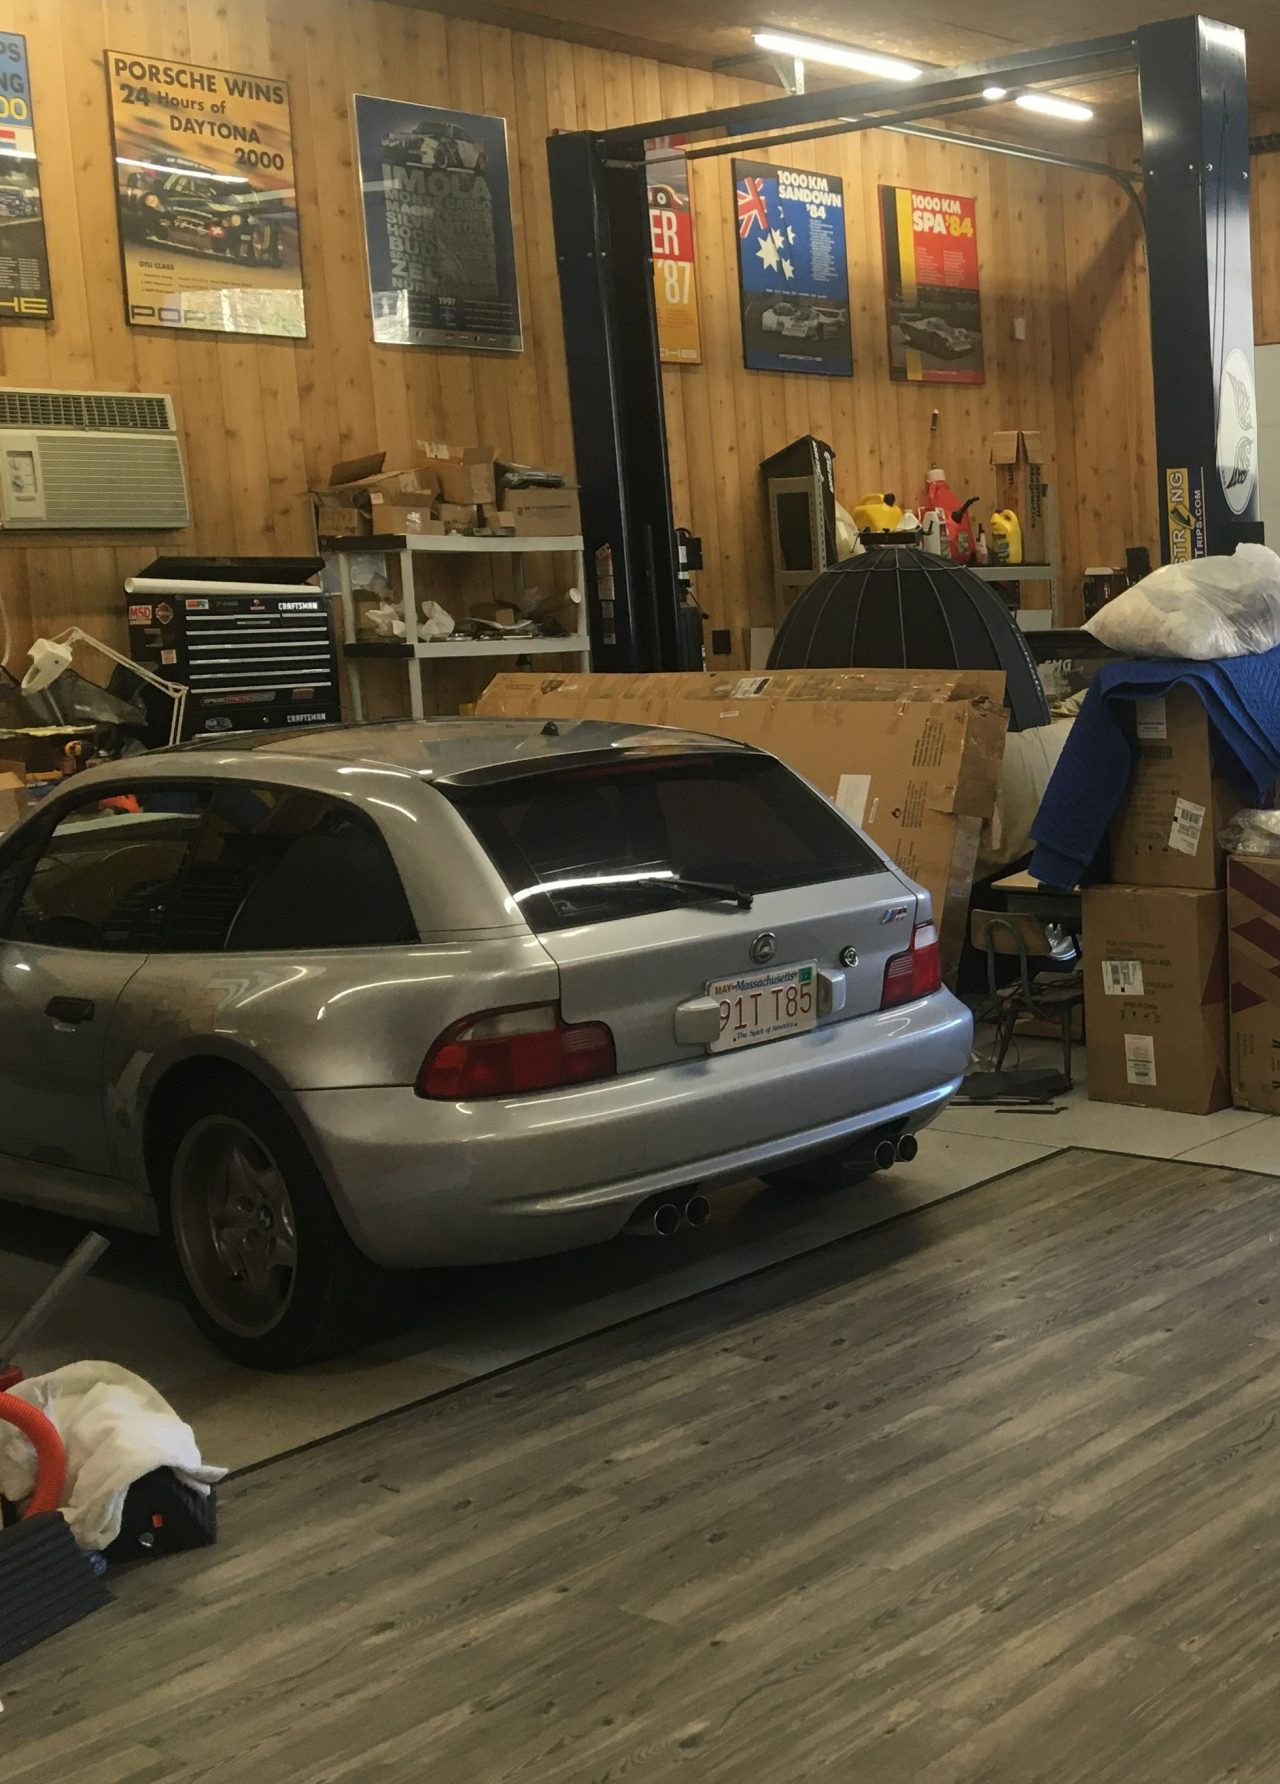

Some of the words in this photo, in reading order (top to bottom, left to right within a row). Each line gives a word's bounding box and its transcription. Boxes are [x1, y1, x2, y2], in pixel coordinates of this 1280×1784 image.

[114, 58, 217, 93] PORSCHE
[224, 77, 284, 105] WINS
[119, 83, 150, 107] 24
[158, 90, 205, 112] Hours
[210, 100, 226, 115] of
[169, 115, 261, 144] DAYTONA
[234, 147, 285, 171] 2000
[382, 163, 492, 201] IMOLA
[777, 170, 808, 188] 1000
[808, 175, 829, 192] KM
[779, 185, 842, 208] SANDOWN
[912, 195, 941, 212] 1000
[941, 199, 961, 215] KM
[806, 203, 827, 219] '84
[912, 211, 947, 235] SPA
[945, 215, 973, 239] '84
[657, 259, 691, 304] '87
[129, 606, 151, 618] MSD
[278, 602, 318, 610] CRAFTSMAN
[286, 713, 326, 723] CRAFTSMAN
[715, 984, 732, 995] MAY
[735, 972, 796, 991] Massachusetts
[720, 993, 763, 1033] 91T
[771, 984, 812, 1021] T85
[737, 1030, 748, 1040] The
